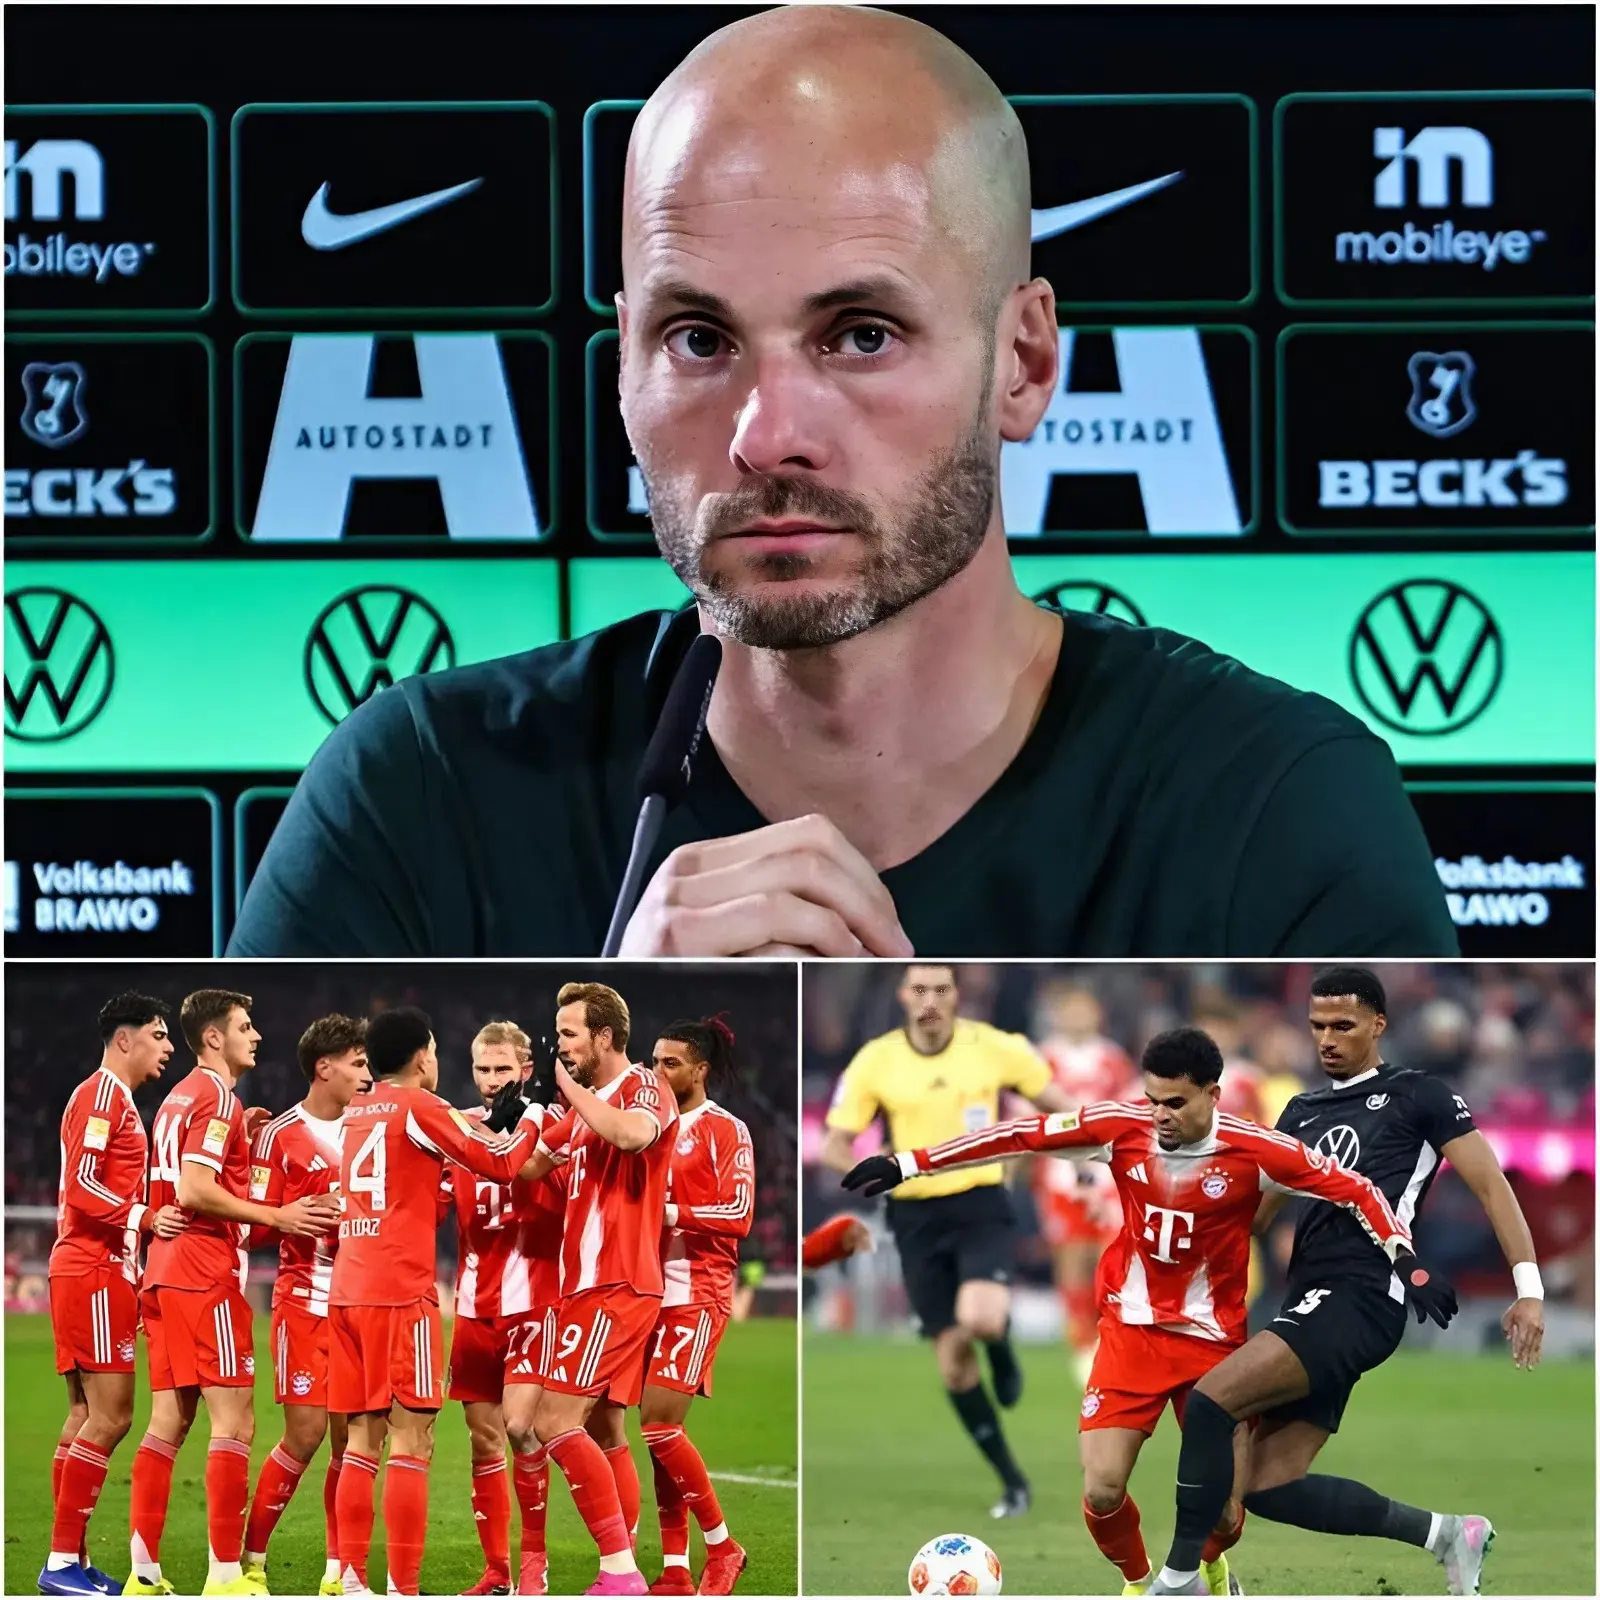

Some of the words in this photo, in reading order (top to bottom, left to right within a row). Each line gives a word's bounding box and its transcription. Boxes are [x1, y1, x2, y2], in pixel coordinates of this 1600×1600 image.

[5, 233, 141, 283] bileye
[1335, 221, 1531, 271] mobileye
[296, 424, 494, 449] AUTOSTADT
[1024, 418, 1194, 443] TOSTADT
[5, 458, 176, 516] ECK'S
[1318, 449, 1568, 507] BECK'S
[33, 860, 192, 895] Volksbank
[35, 897, 159, 932] BRAWO
[1445, 891, 1550, 926] RAWO
[341, 1121, 388, 1211] 4
[556, 1323, 583, 1360] 9
[652, 1323, 696, 1361] 17
